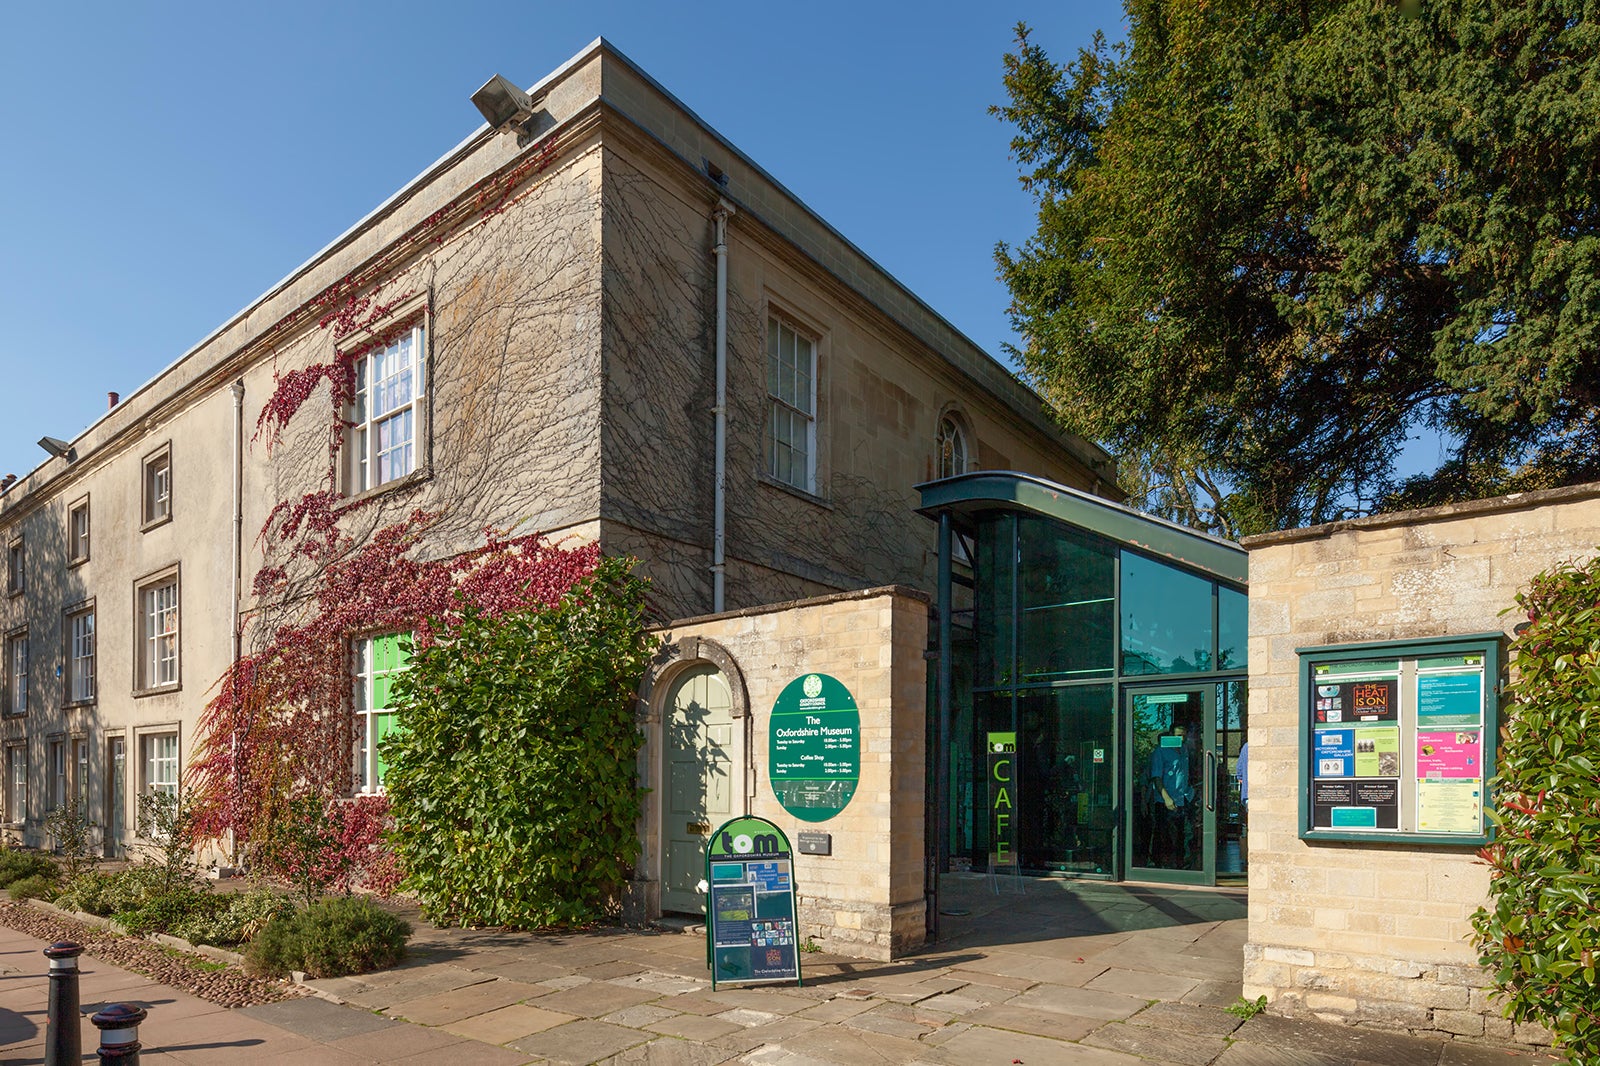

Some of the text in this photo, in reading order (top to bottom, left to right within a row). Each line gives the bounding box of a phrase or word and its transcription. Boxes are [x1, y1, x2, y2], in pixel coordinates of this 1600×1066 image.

[1356, 688, 1385, 698] HEAT
[1356, 697, 1386, 706] IS ON
[806, 716, 820, 724] The
[776, 726, 852, 737] Oxfordshire Museum
[989, 742, 1015, 753] tom
[993, 760, 1012, 863] CAFE
[721, 832, 779, 853] tom
